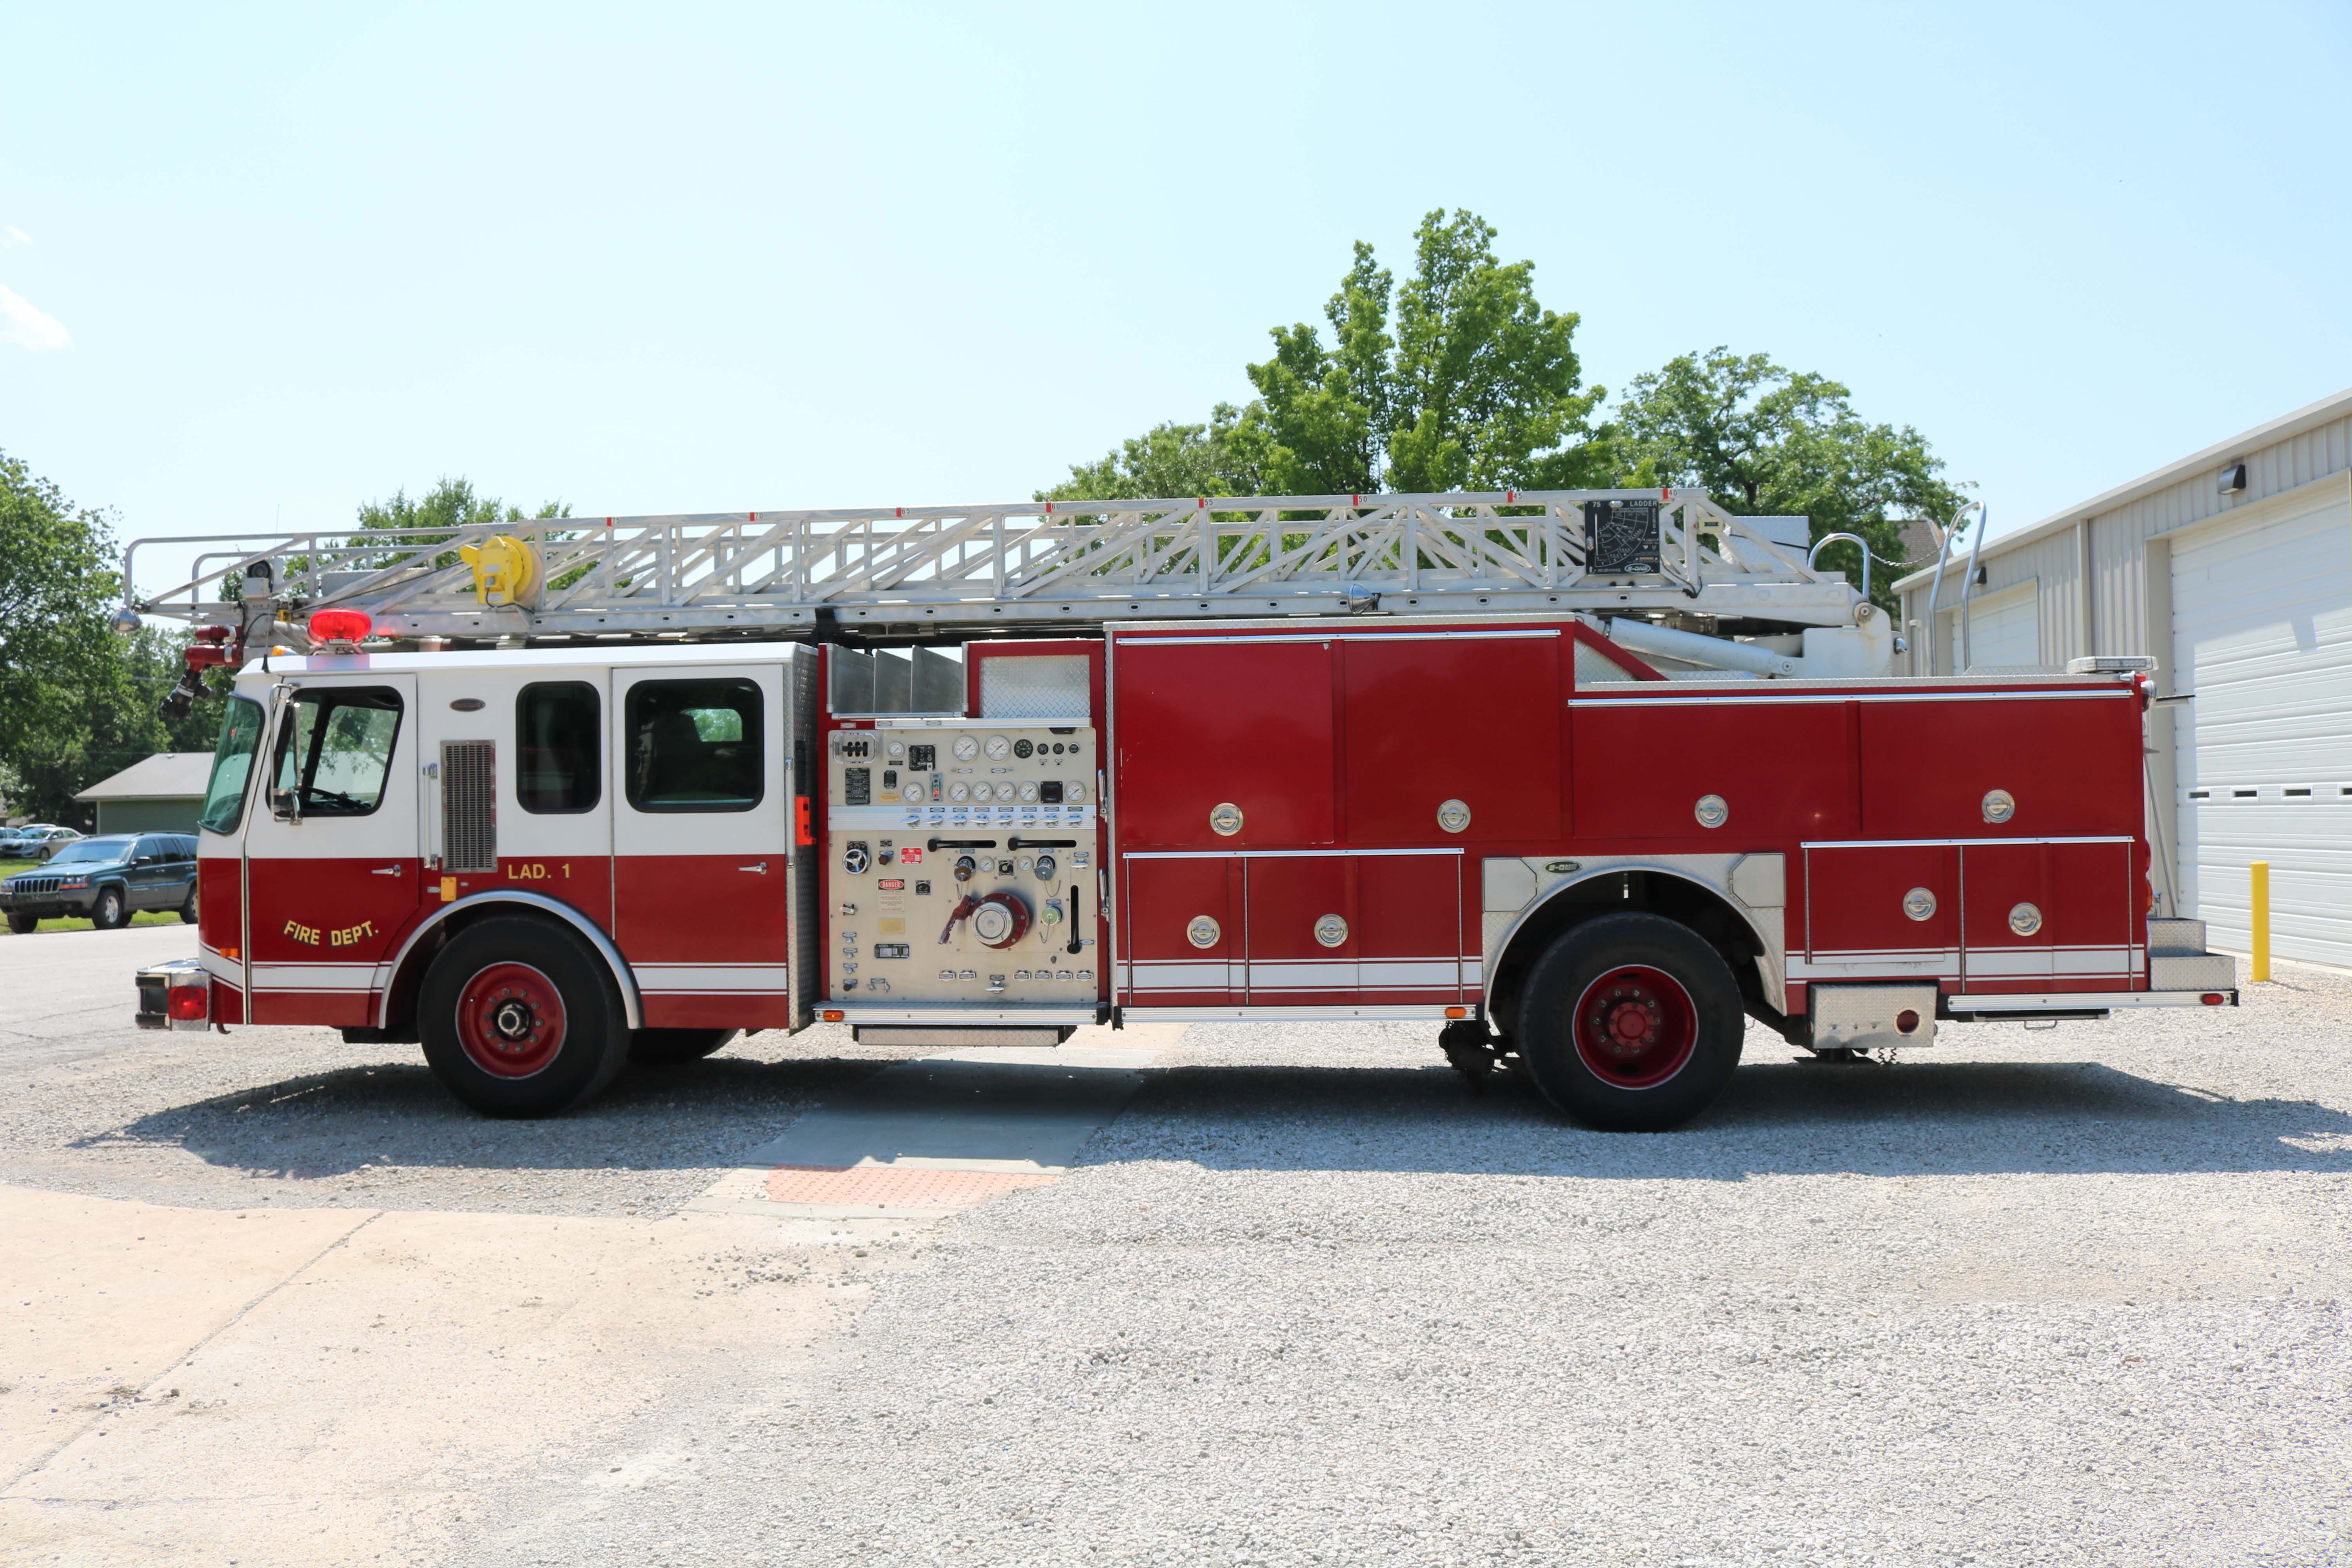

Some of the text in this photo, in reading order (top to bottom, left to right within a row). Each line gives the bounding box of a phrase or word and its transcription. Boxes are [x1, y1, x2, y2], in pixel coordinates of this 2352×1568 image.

[508, 863, 570, 879] LAD. 1
[282, 920, 379, 947] FIRE DEPT.
